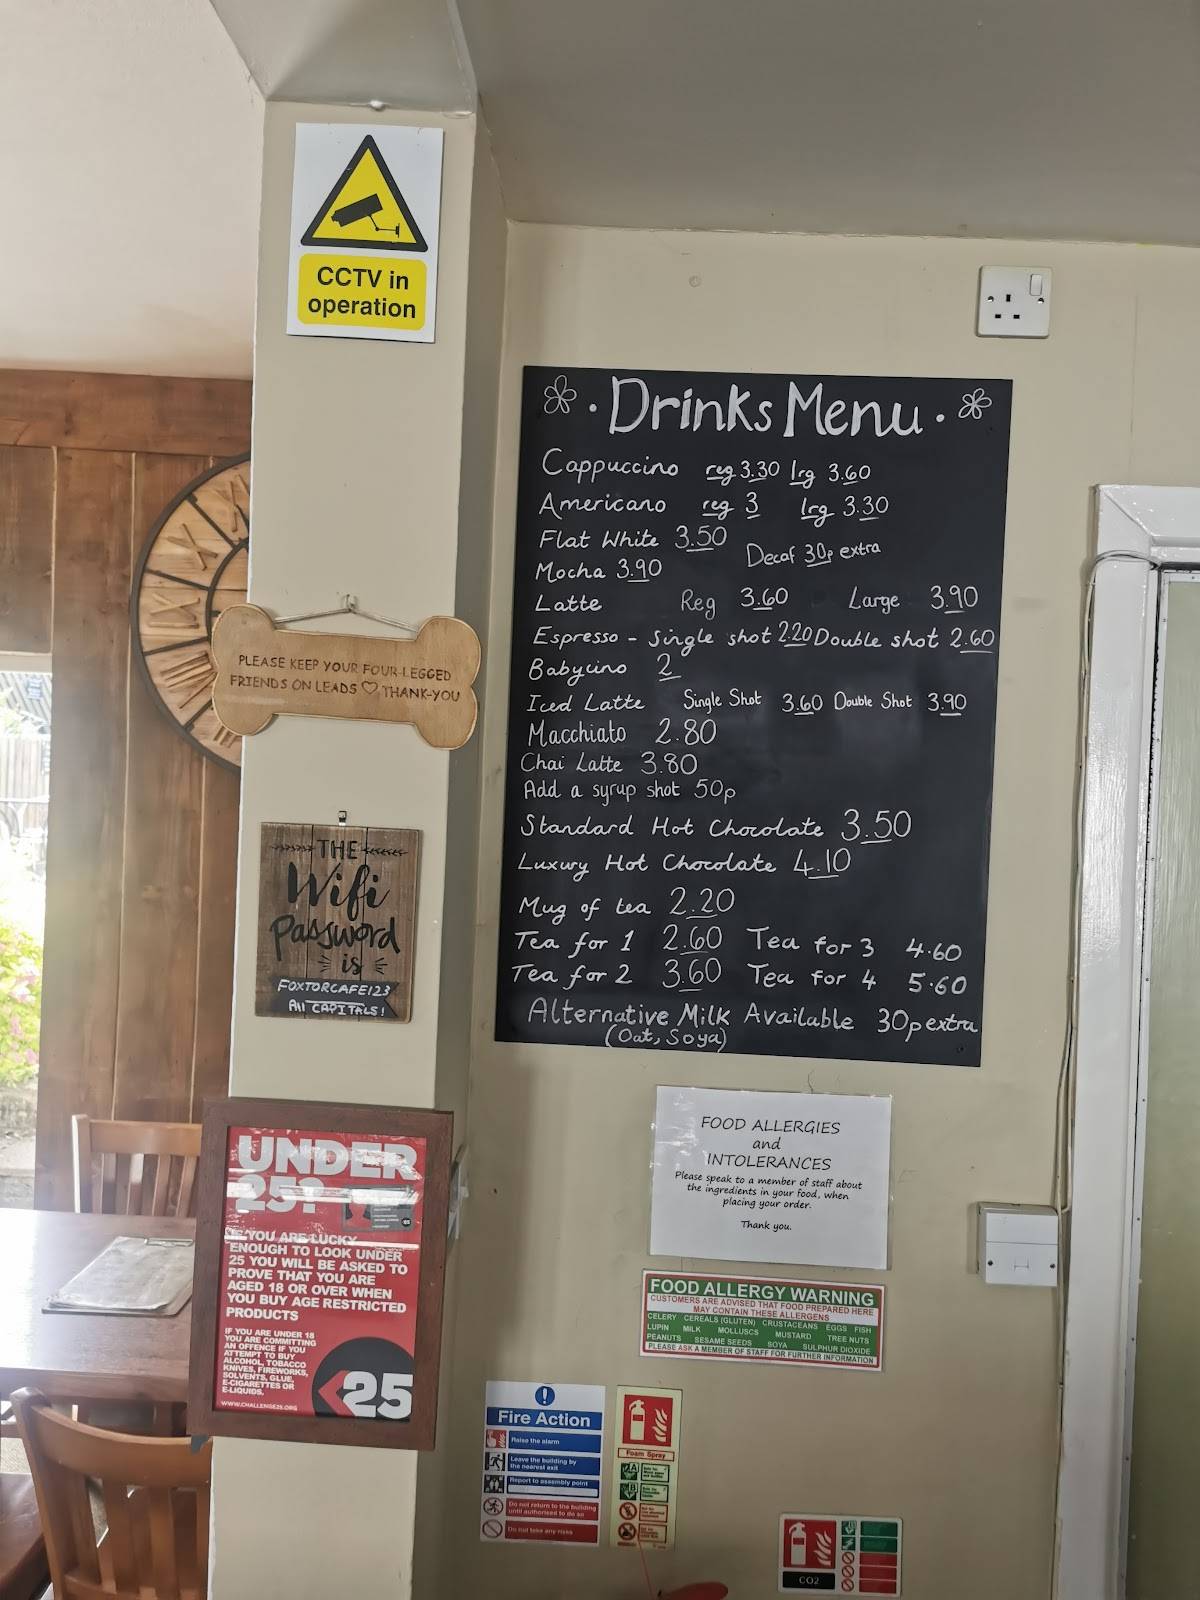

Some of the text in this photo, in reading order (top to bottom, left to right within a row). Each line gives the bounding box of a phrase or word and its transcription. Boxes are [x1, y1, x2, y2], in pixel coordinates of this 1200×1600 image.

[317, 266, 409, 290] CCTV in
[308, 298, 416, 319] operation
[609, 373, 923, 437] Drinks Menu
[542, 448, 870, 489] Cappuccino reg 3.30 lrg 3.60
[539, 492, 888, 527] Americano reg 3 lrg 3.30
[540, 525, 727, 551] Flat White 3.50
[747, 542, 881, 567] Decaf 30p extra
[536, 558, 662, 583] Mocha 3.90
[535, 585, 978, 620] Latte Reg 3.60 Large 3.90
[533, 621, 994, 658] Espresso Single shot 2.20 Double shot 2.60
[238, 655, 285, 668] PLEASE
[290, 658, 319, 671] KEEP
[323, 661, 359, 673] YOUR
[657, 653, 677, 678] 2
[230, 675, 287, 689] FRIENDS
[292, 679, 312, 691] ON
[316, 682, 357, 694] LEADS
[527, 688, 966, 714] Iced Latte Single Shot 3.60 Double Shot 3.90
[528, 718, 716, 747] Macchiato 2.80
[521, 751, 697, 775] Chai Latte 3.80
[525, 779, 736, 806] Add a syrup shot 50p
[521, 809, 911, 844] Standard Hot Chocolate 3.50
[317, 840, 358, 860] THE
[518, 848, 851, 882] Luxury Hot Chocolate 4.10
[288, 862, 390, 921] Wifi
[519, 887, 734, 925] Mug of tea 2.20
[271, 915, 400, 961] Password
[515, 924, 962, 961] Tea for 1 2.60 Tea for 3 4.60
[341, 954, 361, 975] is
[512, 958, 967, 995] Tea for 2 3.60 Tea for 4 5.60
[277, 979, 391, 996] FOXTORCAFE123
[289, 999, 305, 1012] All
[528, 997, 978, 1042] Alternative Milk Available 30p extra
[665, 1025, 729, 1055] Soya)
[701, 1116, 840, 1135] FOOD ALLERGIES
[752, 1137, 781, 1150] and
[238, 1135, 422, 1181] UNDER
[707, 1153, 832, 1171] INTOLERANCES
[675, 1170, 703, 1181] Please
[706, 1174, 732, 1184] speak
[736, 1175, 745, 1184] to
[757, 1176, 797, 1186] member
[799, 1178, 809, 1187] of
[811, 1178, 834, 1188] staff
[836, 1180, 863, 1190] about
[687, 1183, 702, 1192] the
[705, 1185, 757, 1198] ingredients
[760, 1187, 770, 1196] in
[772, 1189, 794, 1199] your
[824, 1190, 849, 1200] when
[722, 1198, 813, 1210] placing your order.
[741, 1220, 792, 1232] Thank you.
[228, 1269, 376, 1286] PROVE THAT YOU ARE
[650, 1279, 875, 1306] FOOD ALLERGY WARNING
[226, 1307, 299, 1322] PRODUCTS
[647, 1313, 676, 1322] CELERY
[684, 1315, 719, 1323] CEREALS
[721, 1317, 756, 1326] (GLUTEN)
[762, 1320, 818, 1330] CRUSTACEANS
[826, 1325, 847, 1333] EGGS
[342, 1371, 413, 1419] 25
[498, 1410, 591, 1427] Fire Action
